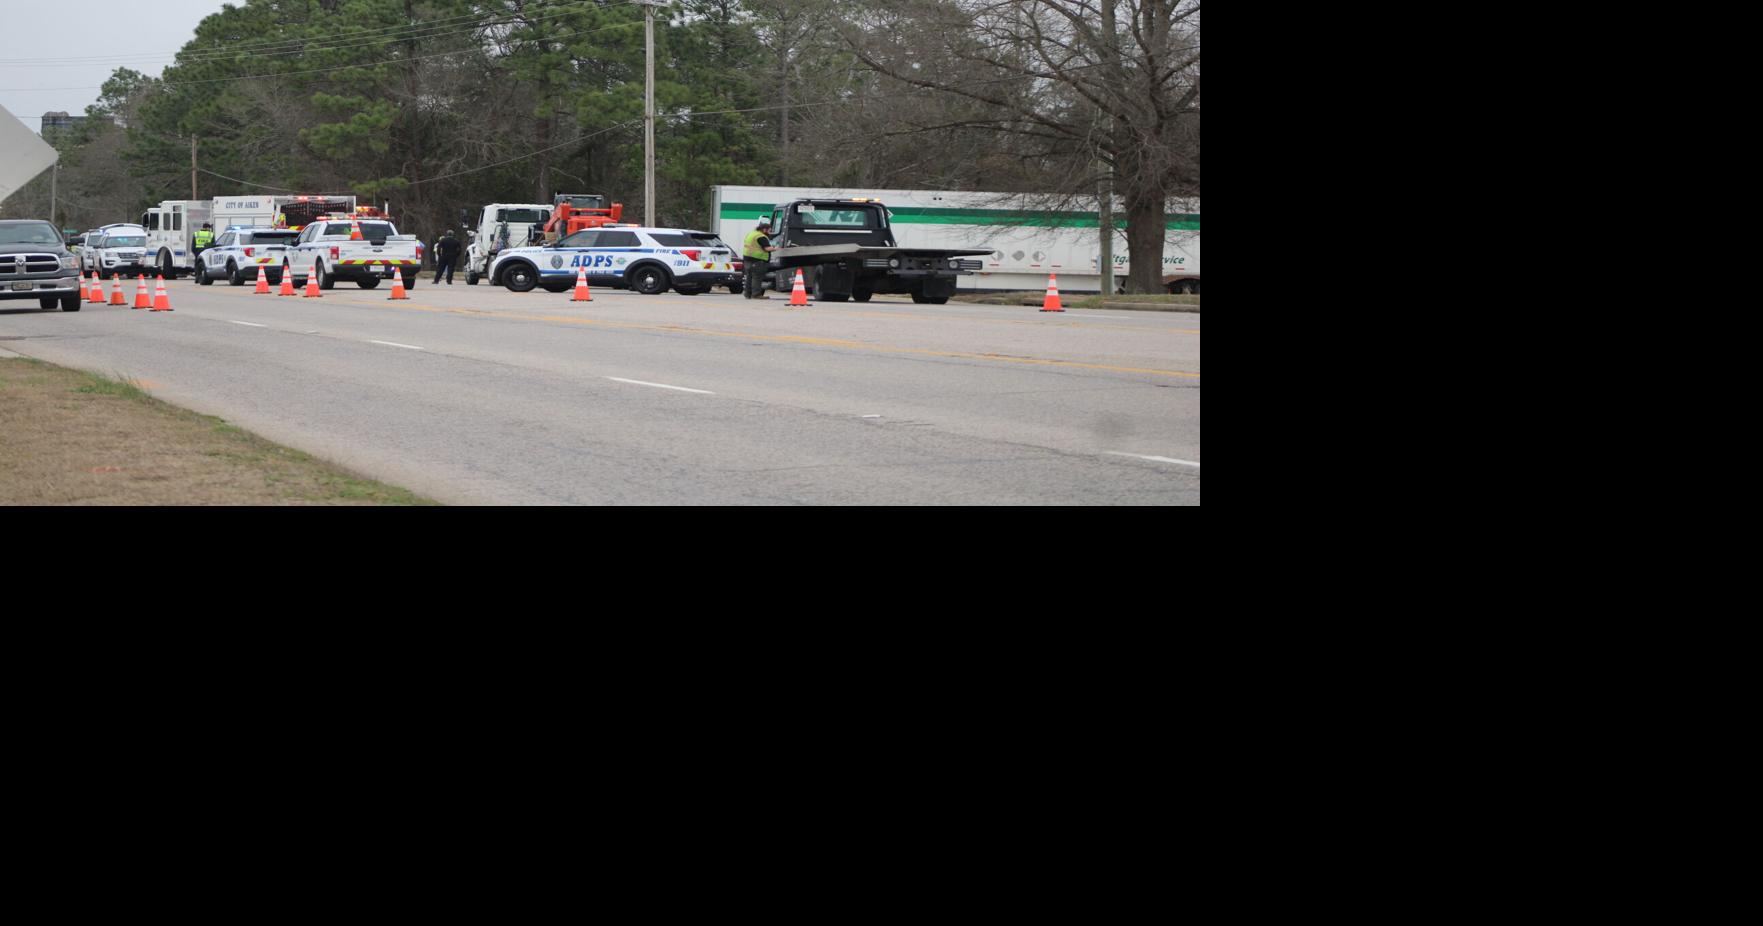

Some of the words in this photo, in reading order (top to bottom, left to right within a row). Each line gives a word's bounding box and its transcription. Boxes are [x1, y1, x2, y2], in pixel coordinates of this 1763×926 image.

[225, 201, 237, 209] CITY
[244, 201, 260, 209] AIKEN
[570, 255, 614, 268] ADPS
